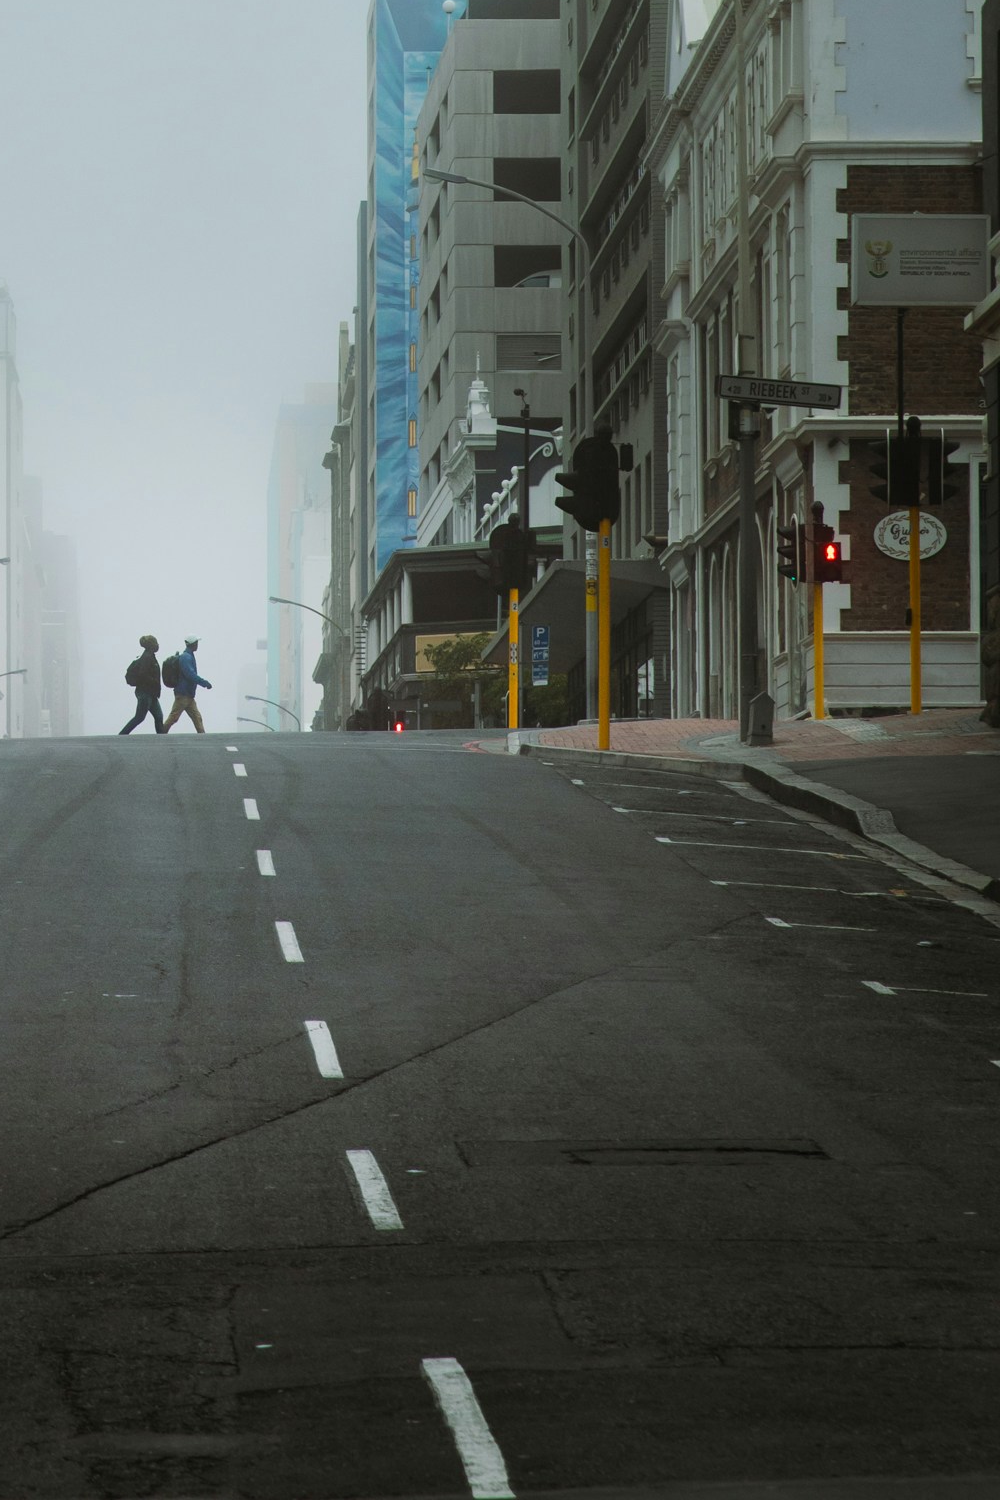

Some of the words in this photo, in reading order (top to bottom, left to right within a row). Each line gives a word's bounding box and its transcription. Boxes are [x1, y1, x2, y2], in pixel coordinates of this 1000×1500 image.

[750, 383, 797, 399] RIEBEEK
[801, 387, 810, 395] ST
[891, 523, 929, 540] Giuo's
[604, 538, 608, 546] 5
[536, 627, 545, 637] P
